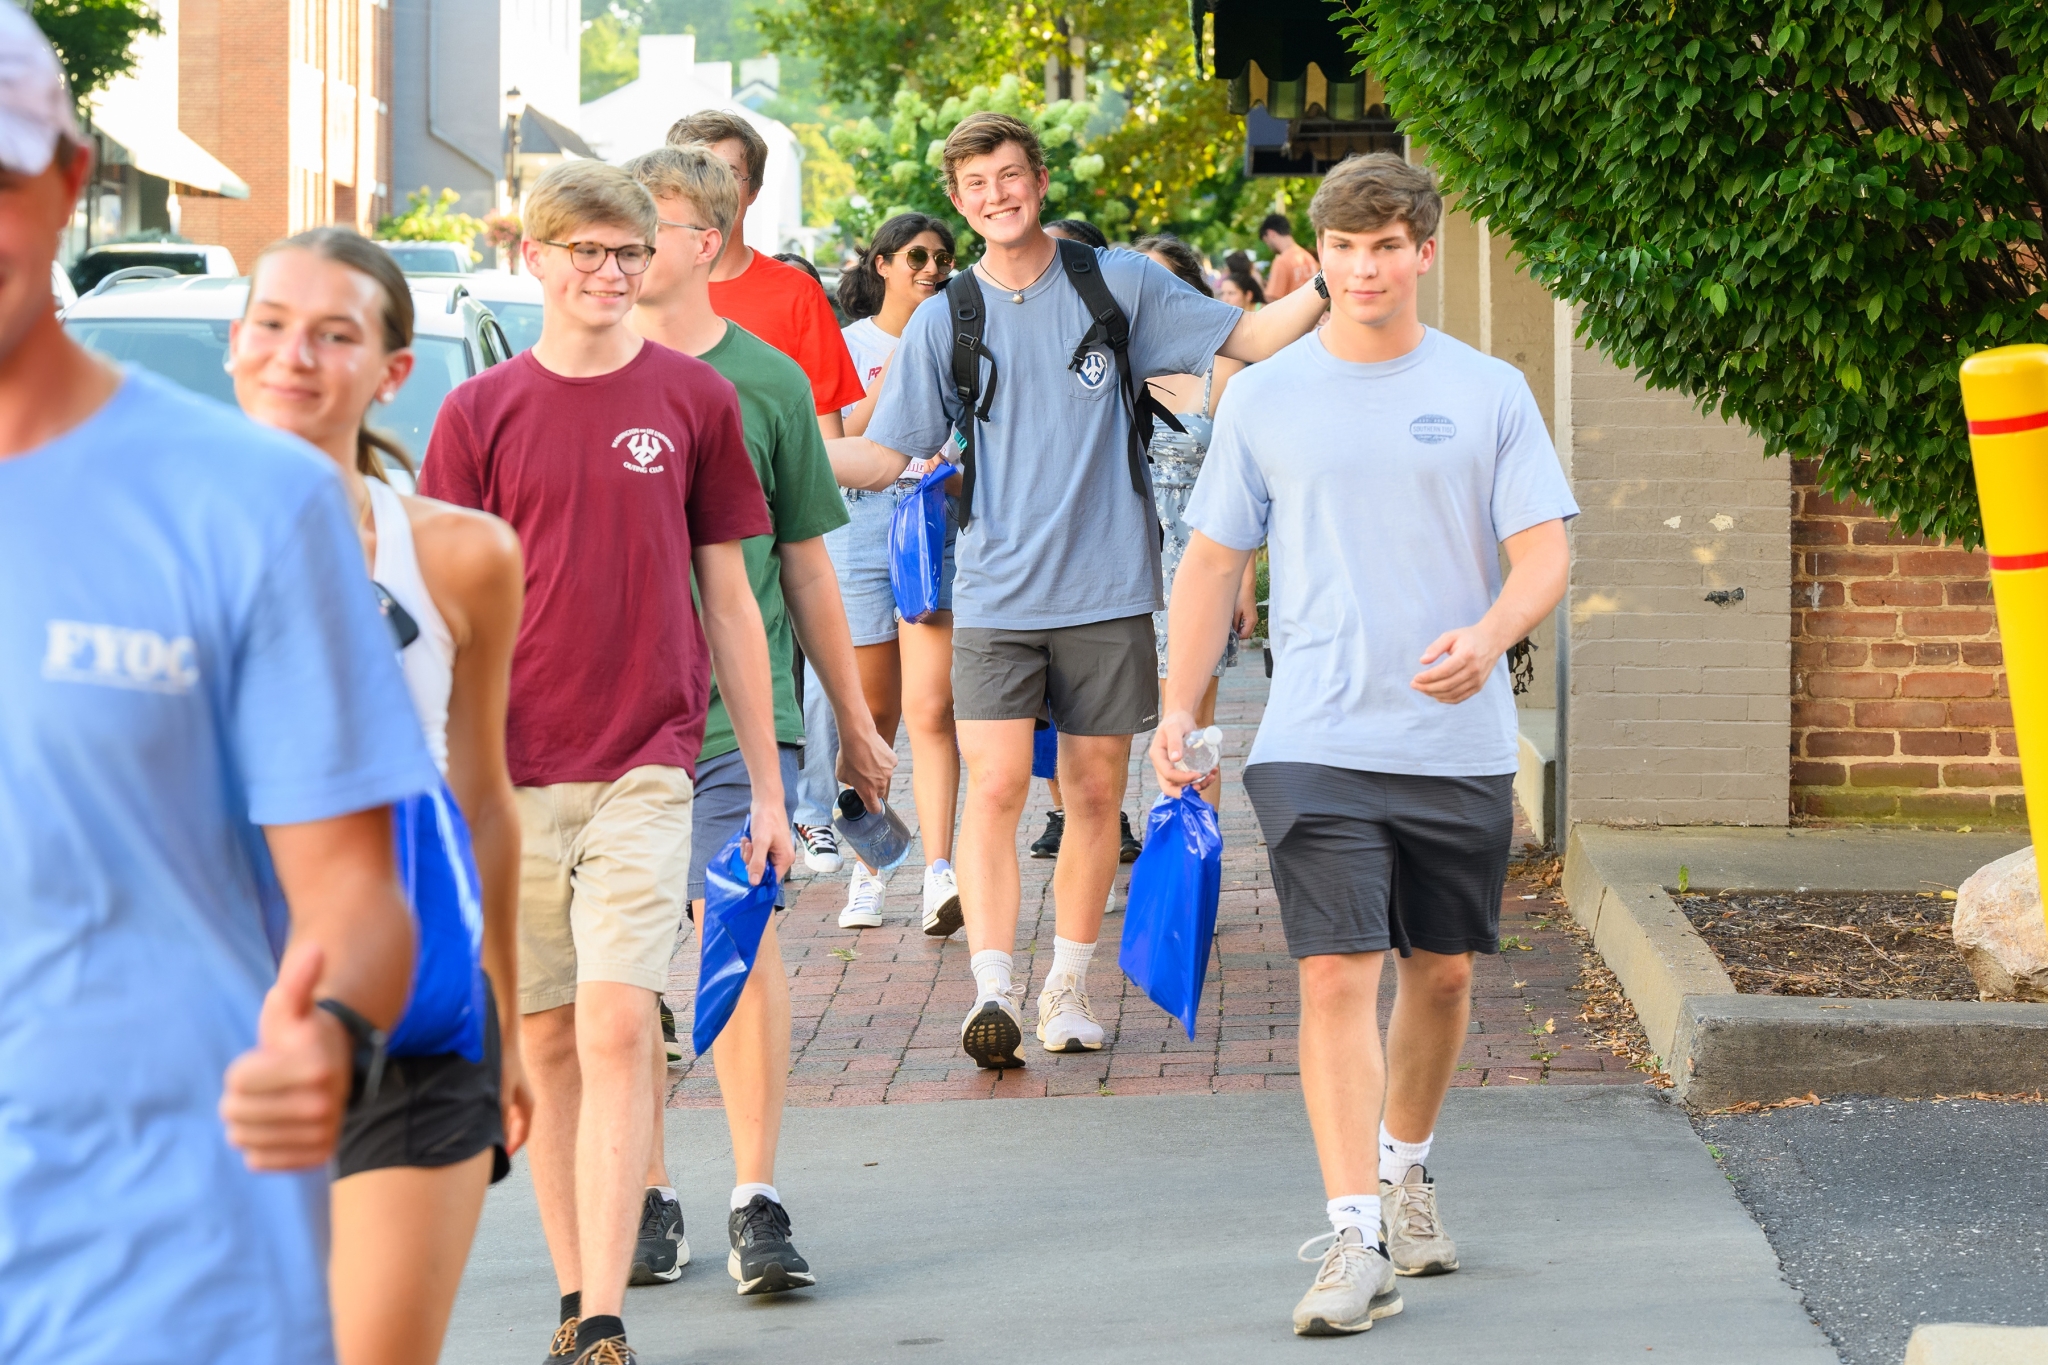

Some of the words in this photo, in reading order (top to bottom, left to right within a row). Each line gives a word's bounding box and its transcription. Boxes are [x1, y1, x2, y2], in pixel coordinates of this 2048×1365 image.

[1413, 425, 1441, 433] SOUTHERN
[1441, 426, 1453, 434] TIDE
[623, 461, 648, 474] OUTING
[648, 465, 665, 474] CLUB
